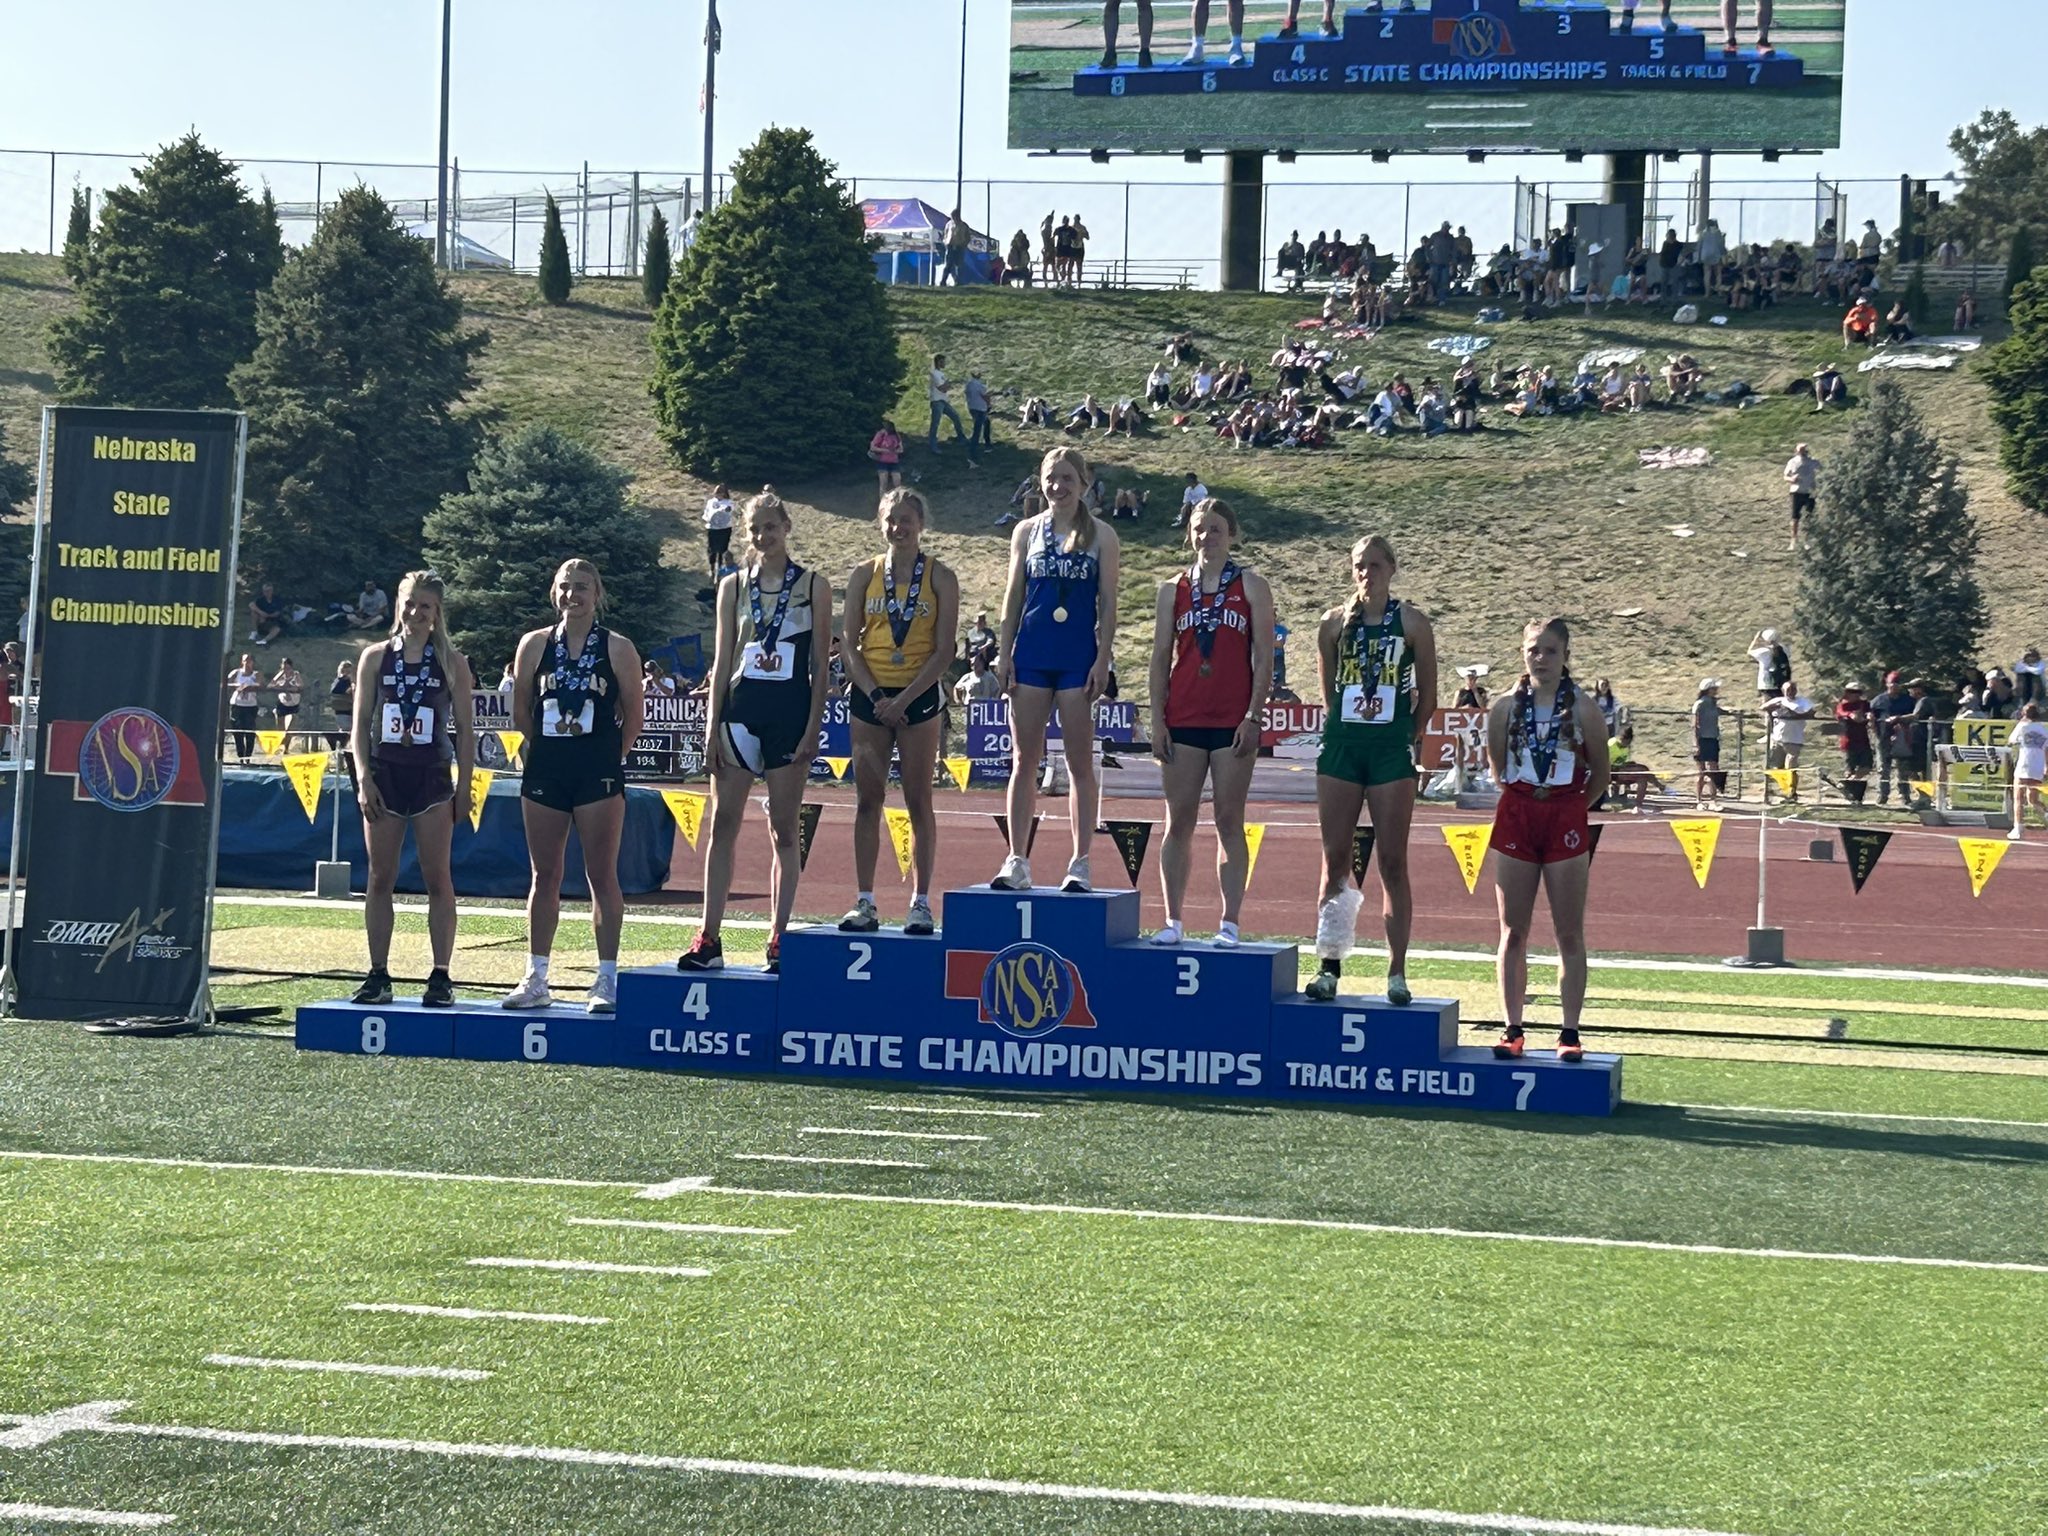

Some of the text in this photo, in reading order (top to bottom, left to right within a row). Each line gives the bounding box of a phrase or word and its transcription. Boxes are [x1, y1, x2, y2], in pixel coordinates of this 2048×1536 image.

[1379, 17, 1394, 38] 2
[1557, 14, 1572, 35] 3
[1291, 44, 1306, 64] 4
[1649, 38, 1665, 59] 5
[1110, 75, 1126, 96] 8
[1202, 71, 1217, 92] 6
[1272, 68, 1329, 83] CLASS C
[1344, 61, 1608, 83] STATE CHAMPIONSHIPS
[1620, 64, 1728, 79] TRACK & FIELD
[1747, 63, 1762, 84] 7
[93, 435, 197, 463] Nebraska
[113, 490, 171, 516] State
[58, 543, 221, 573] Track and Field
[50, 597, 221, 629] Championships
[642, 697, 708, 721] CHNICA
[1016, 901, 1032, 939] 1
[847, 942, 872, 980] 2
[1176, 957, 1199, 995] 3
[683, 983, 710, 1020] 4
[361, 1016, 386, 1053] 8
[523, 1023, 548, 1060] 6
[649, 1028, 751, 1056] CLASS C
[1341, 1013, 1366, 1053] 5
[782, 1031, 1262, 1086] STATE CHAMPIONSHIPS
[1286, 1062, 1475, 1096] TRACK & FIELD
[1511, 1072, 1536, 1111] 7
